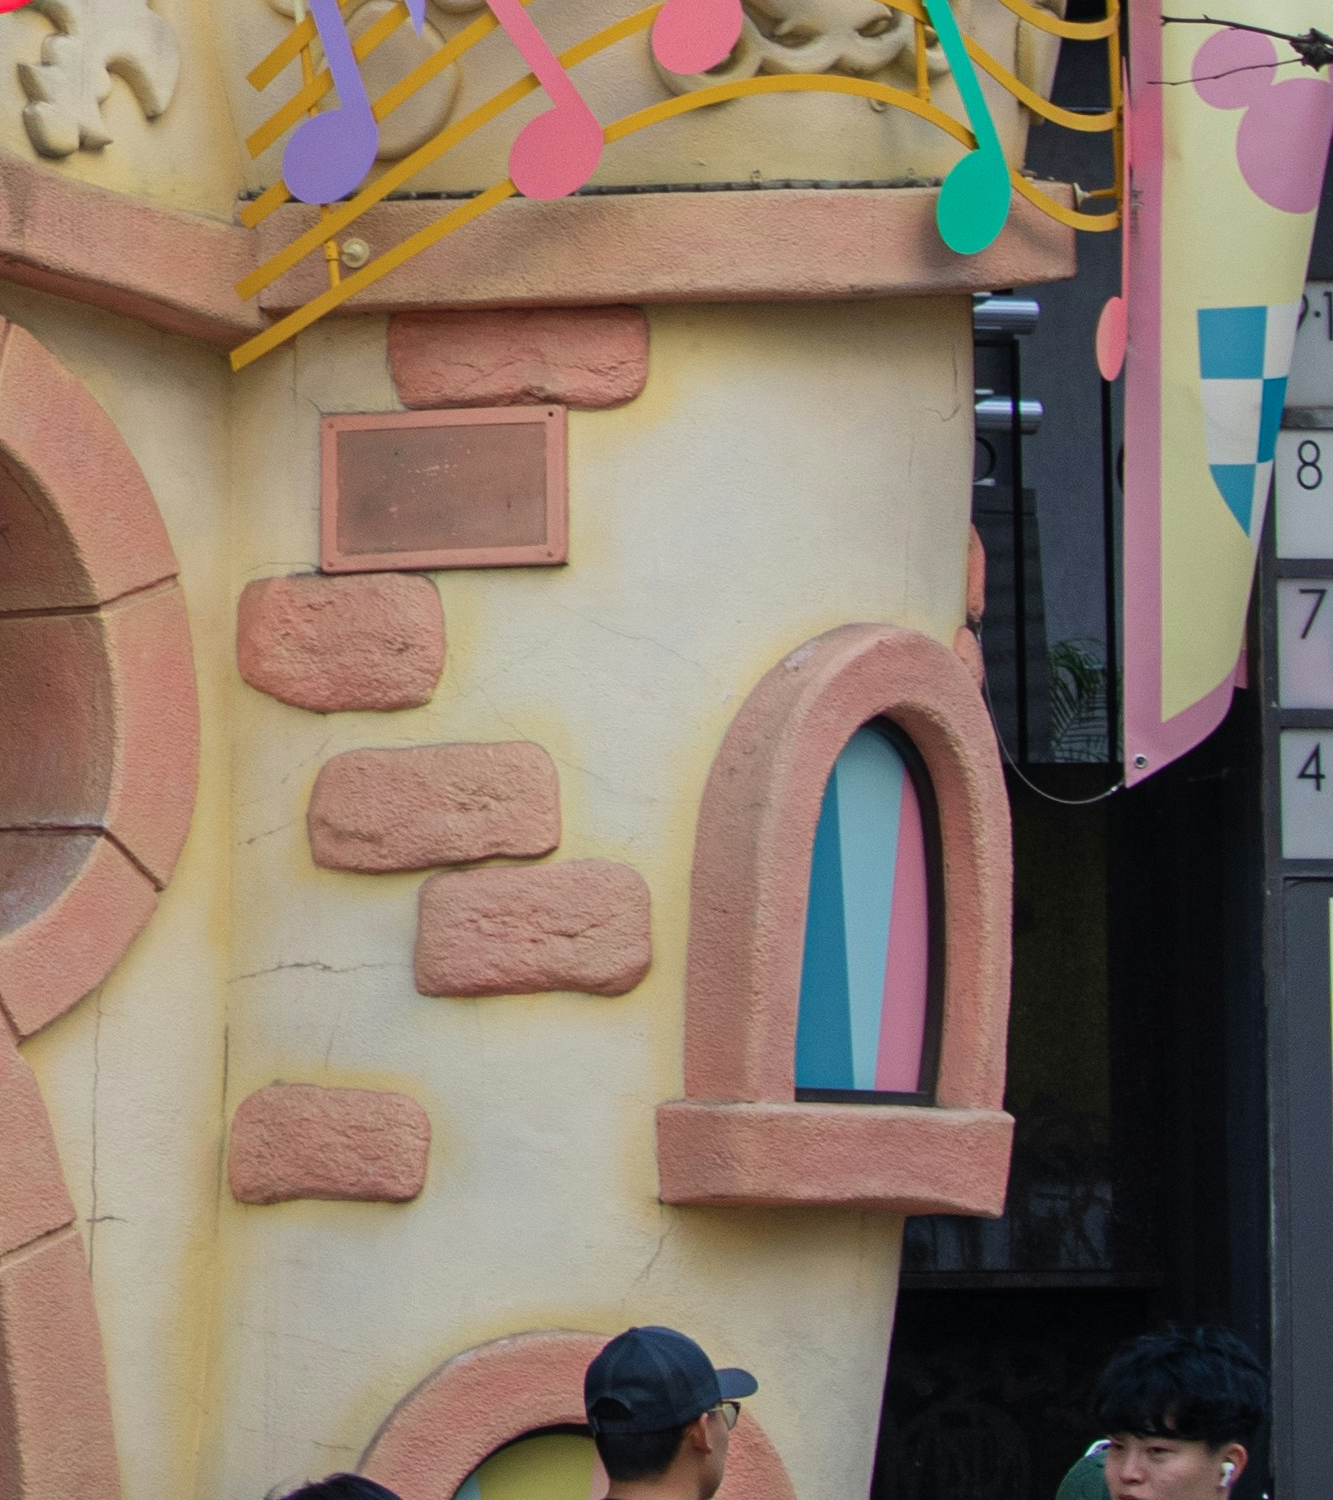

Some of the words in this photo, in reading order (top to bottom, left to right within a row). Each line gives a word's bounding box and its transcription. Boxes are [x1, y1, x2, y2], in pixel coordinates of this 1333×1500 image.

[1295, 439, 1325, 492] 8
[1297, 588, 1329, 641] 7
[1296, 742, 1327, 793] 4
